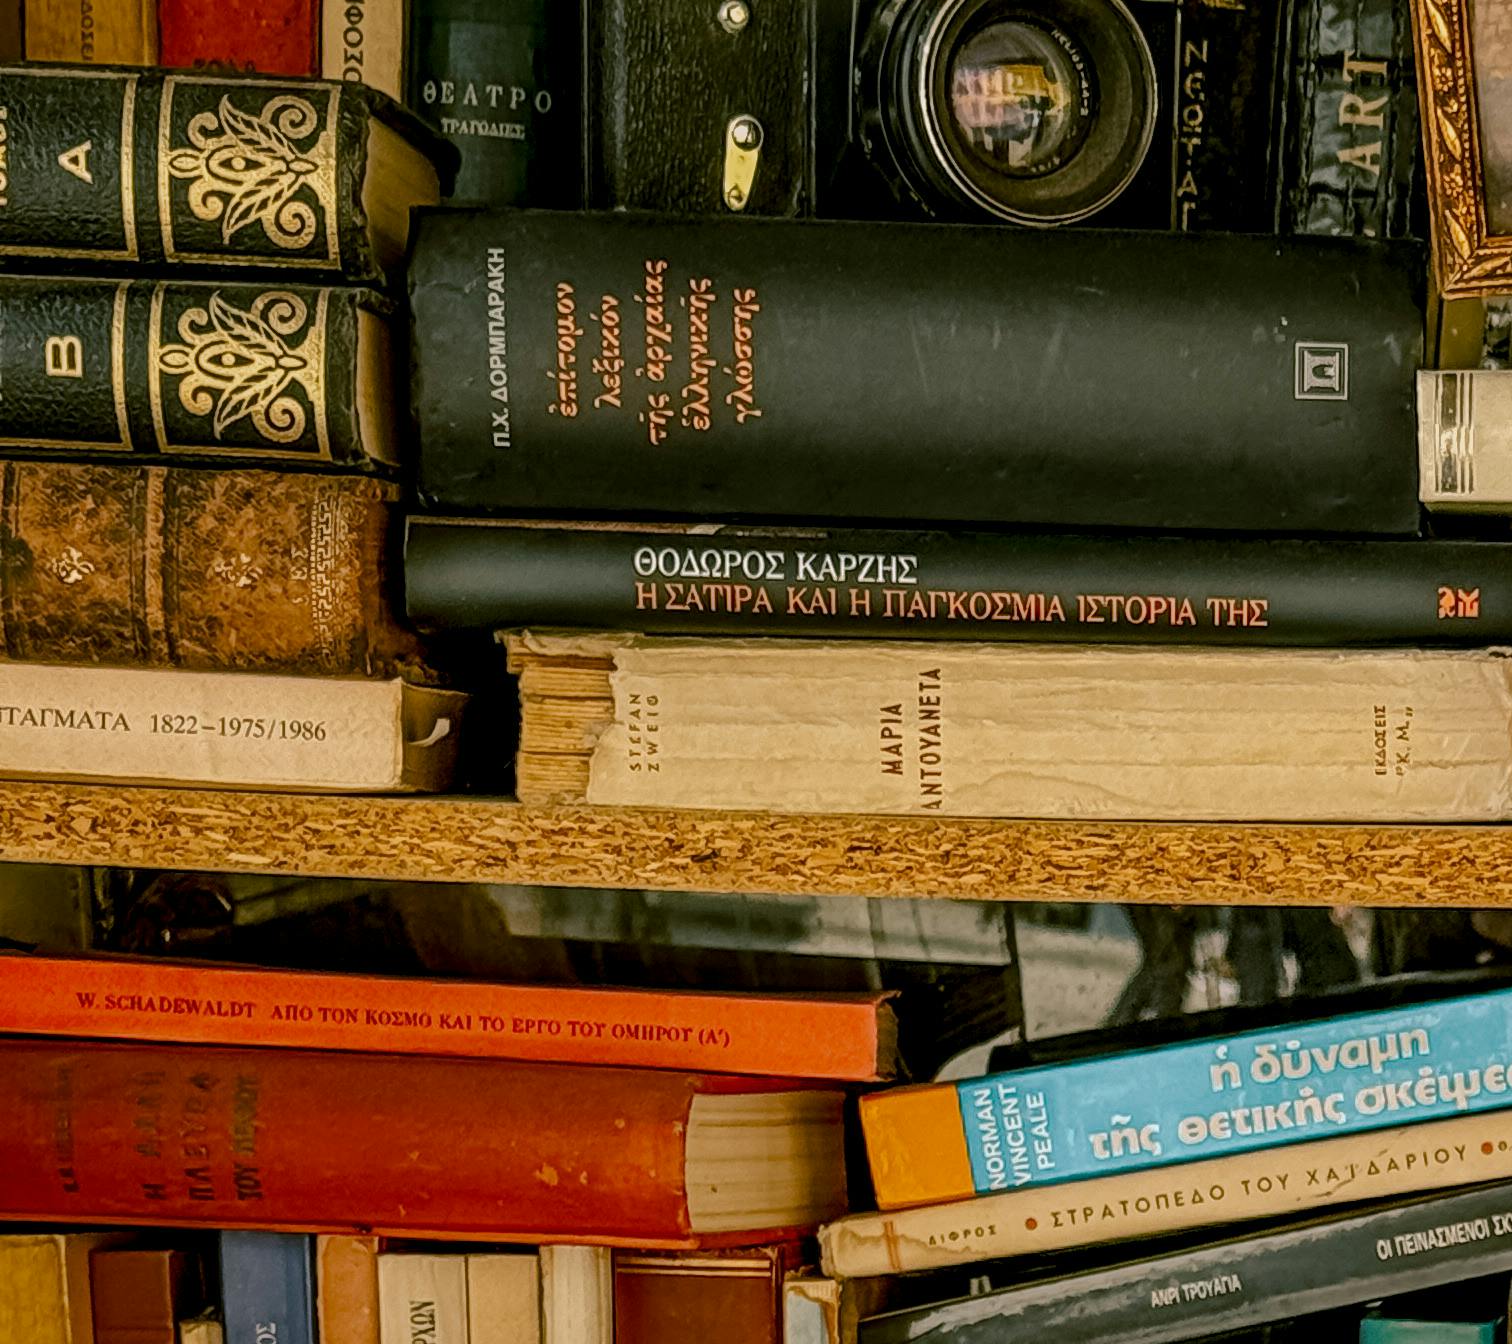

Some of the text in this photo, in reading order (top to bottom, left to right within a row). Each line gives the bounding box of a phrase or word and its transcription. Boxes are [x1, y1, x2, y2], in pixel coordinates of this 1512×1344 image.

[422, 80, 552, 114] ΘΕΑΤΡΟ
[1336, 51, 1388, 175] ART
[488, 249, 508, 400] ΔΟΡΜΠΑΡΑΚΗ
[634, 548, 919, 586] ΘΟΔΩΡΟΣ ΚΑΡΖΗΣ
[636, 583, 1269, 628] Η ΣΑΤΙΡΑ ΚΑΙ Η ΠΑΓΚΟΣΜΙΑ ΙΣΤΟΡΙΑ ΤΗΣ
[881, 703, 903, 775] ΜΑΡΙΑ
[919, 668, 943, 810] ΑΝΤΟΥΑΝΕΤΑ
[104, 994, 256, 1019] SCHADEWALDT
[271, 1004, 312, 1021] ΑΠΟ
[319, 1006, 358, 1025] ΤΟΝ
[364, 1009, 432, 1028] ΚΟΣΜΟ
[439, 1013, 473, 1030] ΚΑΙ
[479, 1016, 505, 1031] ΤΟ
[511, 1016, 561, 1036] ΕΡΓΟ
[969, 1087, 1004, 1191] NORMAN
[998, 1082, 1032, 1186] VINCENT
[1026, 1089, 1055, 1171] PEALE
[1051, 1183, 1227, 1230] ΣΤΡΑΤΟΠΕΔΟ
[1240, 1171, 1291, 1196] ΤΟΥ
